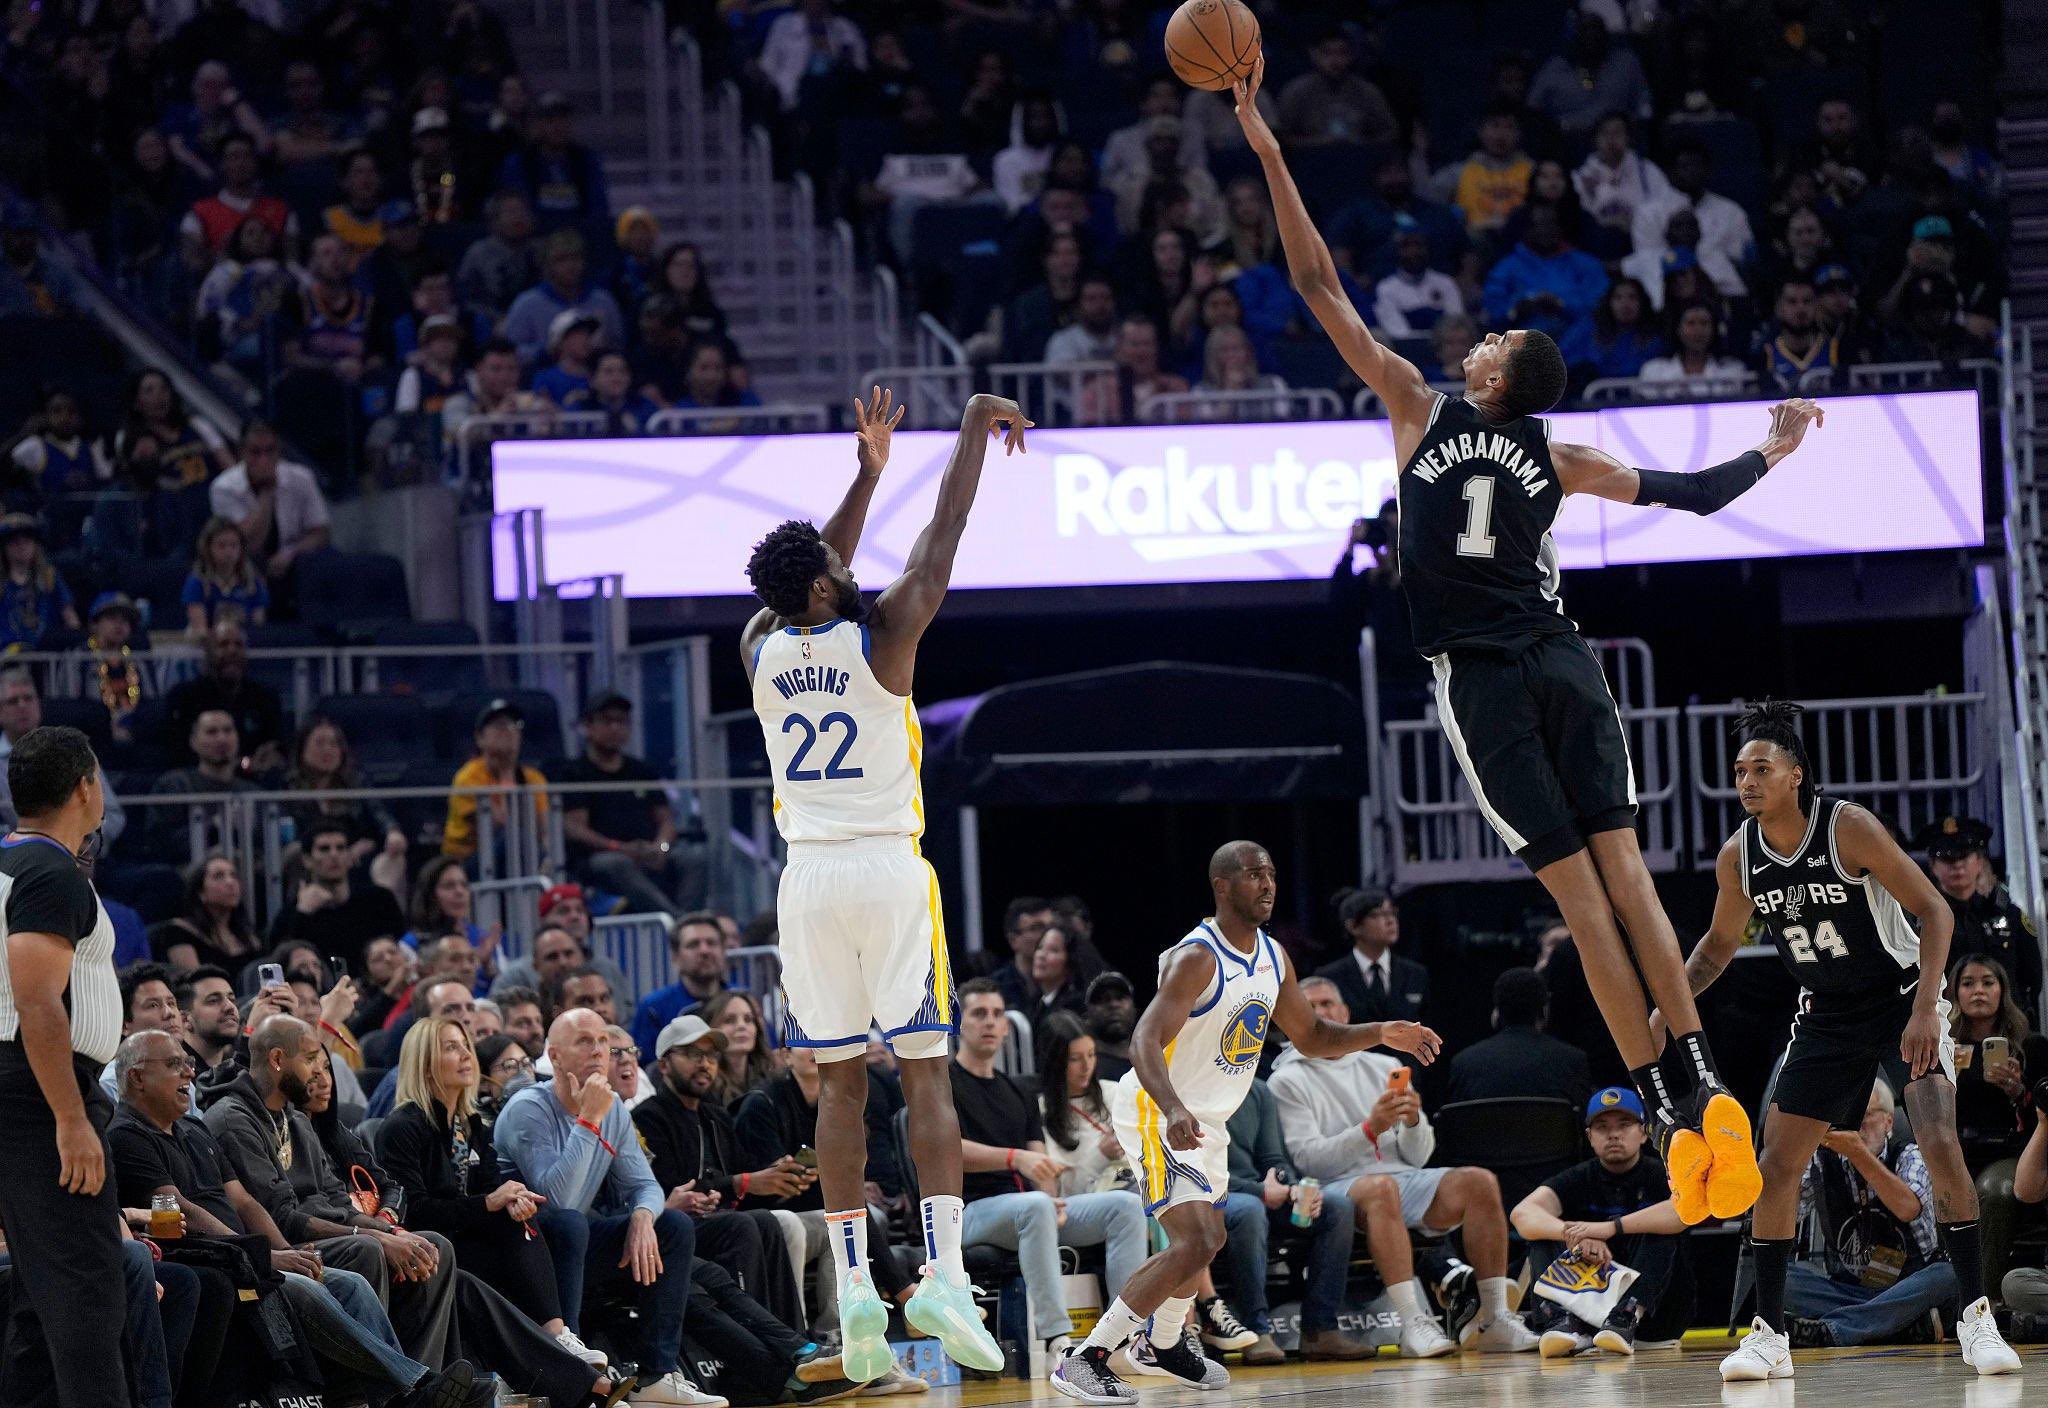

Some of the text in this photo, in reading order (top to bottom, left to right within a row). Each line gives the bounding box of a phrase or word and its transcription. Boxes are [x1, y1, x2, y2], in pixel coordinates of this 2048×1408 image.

[1411, 431, 1549, 498] WEMBANYAMA
[1456, 475, 1497, 559] 1
[771, 666, 850, 700] WIGGINS
[781, 711, 864, 781] 22
[1753, 883, 1848, 920] SPURS
[1783, 920, 1850, 963] 24
[1227, 992, 1254, 1018] GOLDEN
[1255, 1015, 1266, 1034] 3
[1214, 1055, 1260, 1076] WARRIO
[1337, 1312, 1402, 1331] CHASE
